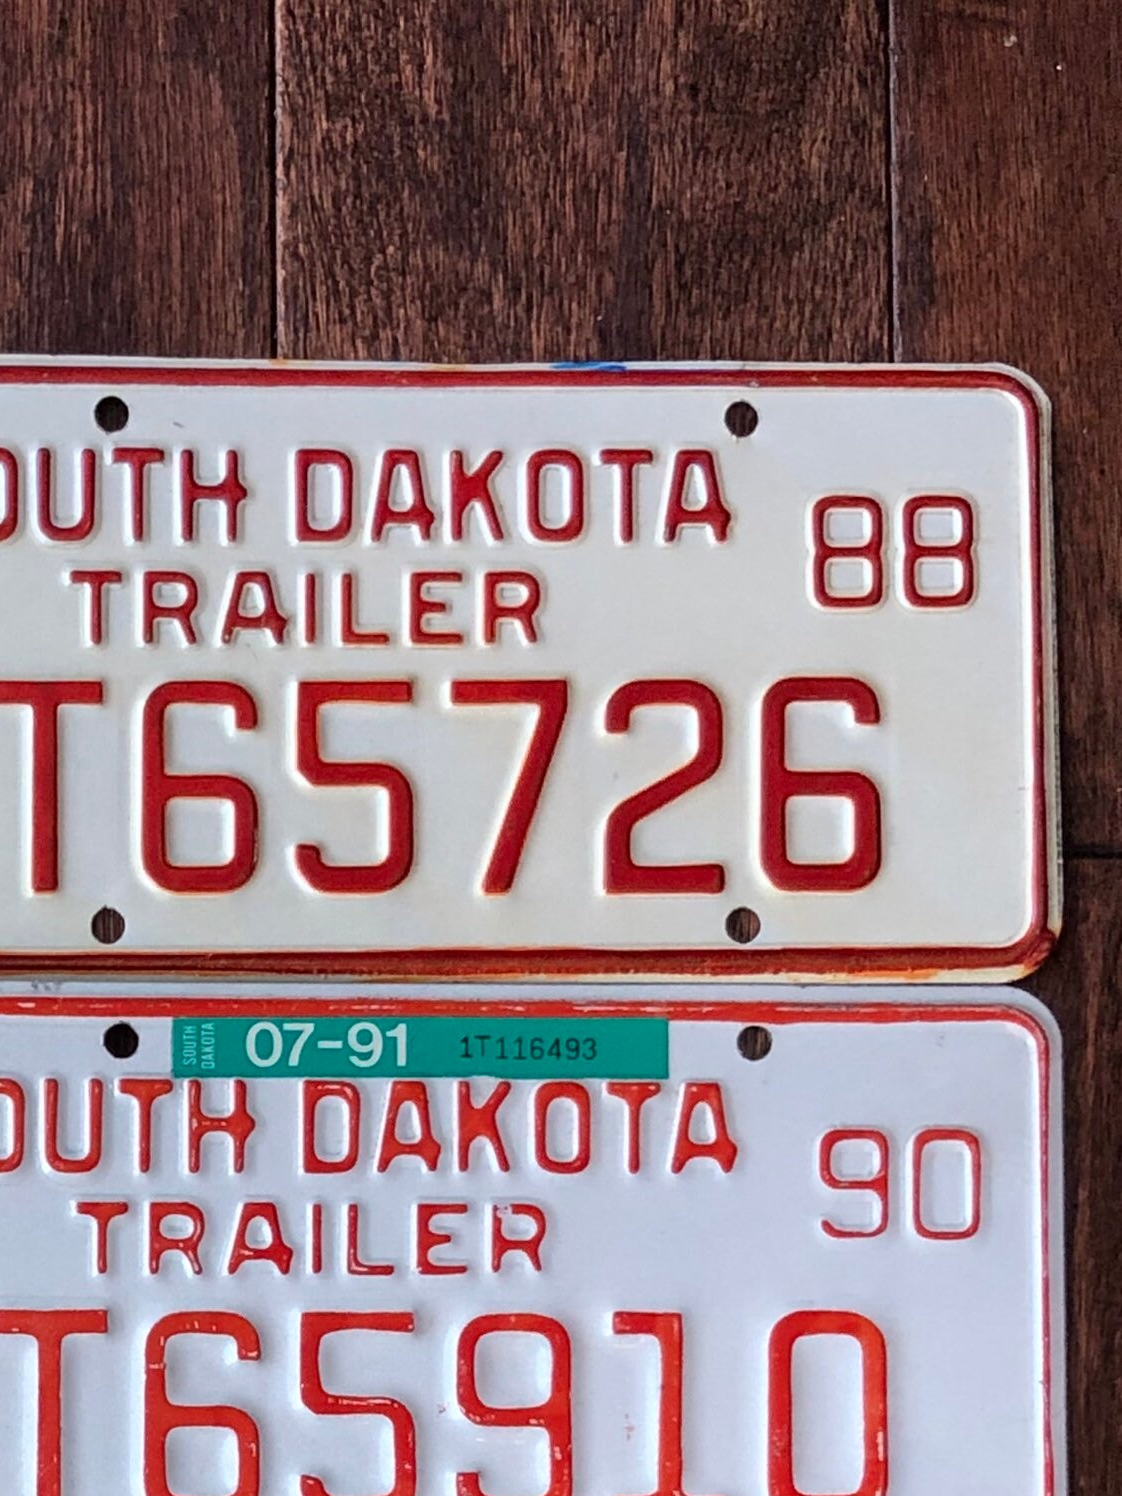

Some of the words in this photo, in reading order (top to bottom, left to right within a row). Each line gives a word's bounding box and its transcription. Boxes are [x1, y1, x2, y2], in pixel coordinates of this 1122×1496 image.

[295, 446, 732, 545] DAKOTA
[810, 494, 975, 610] 88
[70, 569, 545, 648] TRAILER
[182, 1025, 197, 1066] SOUTH
[201, 1023, 216, 1069] DAKOTA
[244, 1021, 410, 1068] 07-91
[459, 1034, 599, 1061] 1T116493
[303, 1079, 739, 1174] DAKOTA
[819, 1127, 981, 1241] 90
[76, 1201, 548, 1277] TRAILER
